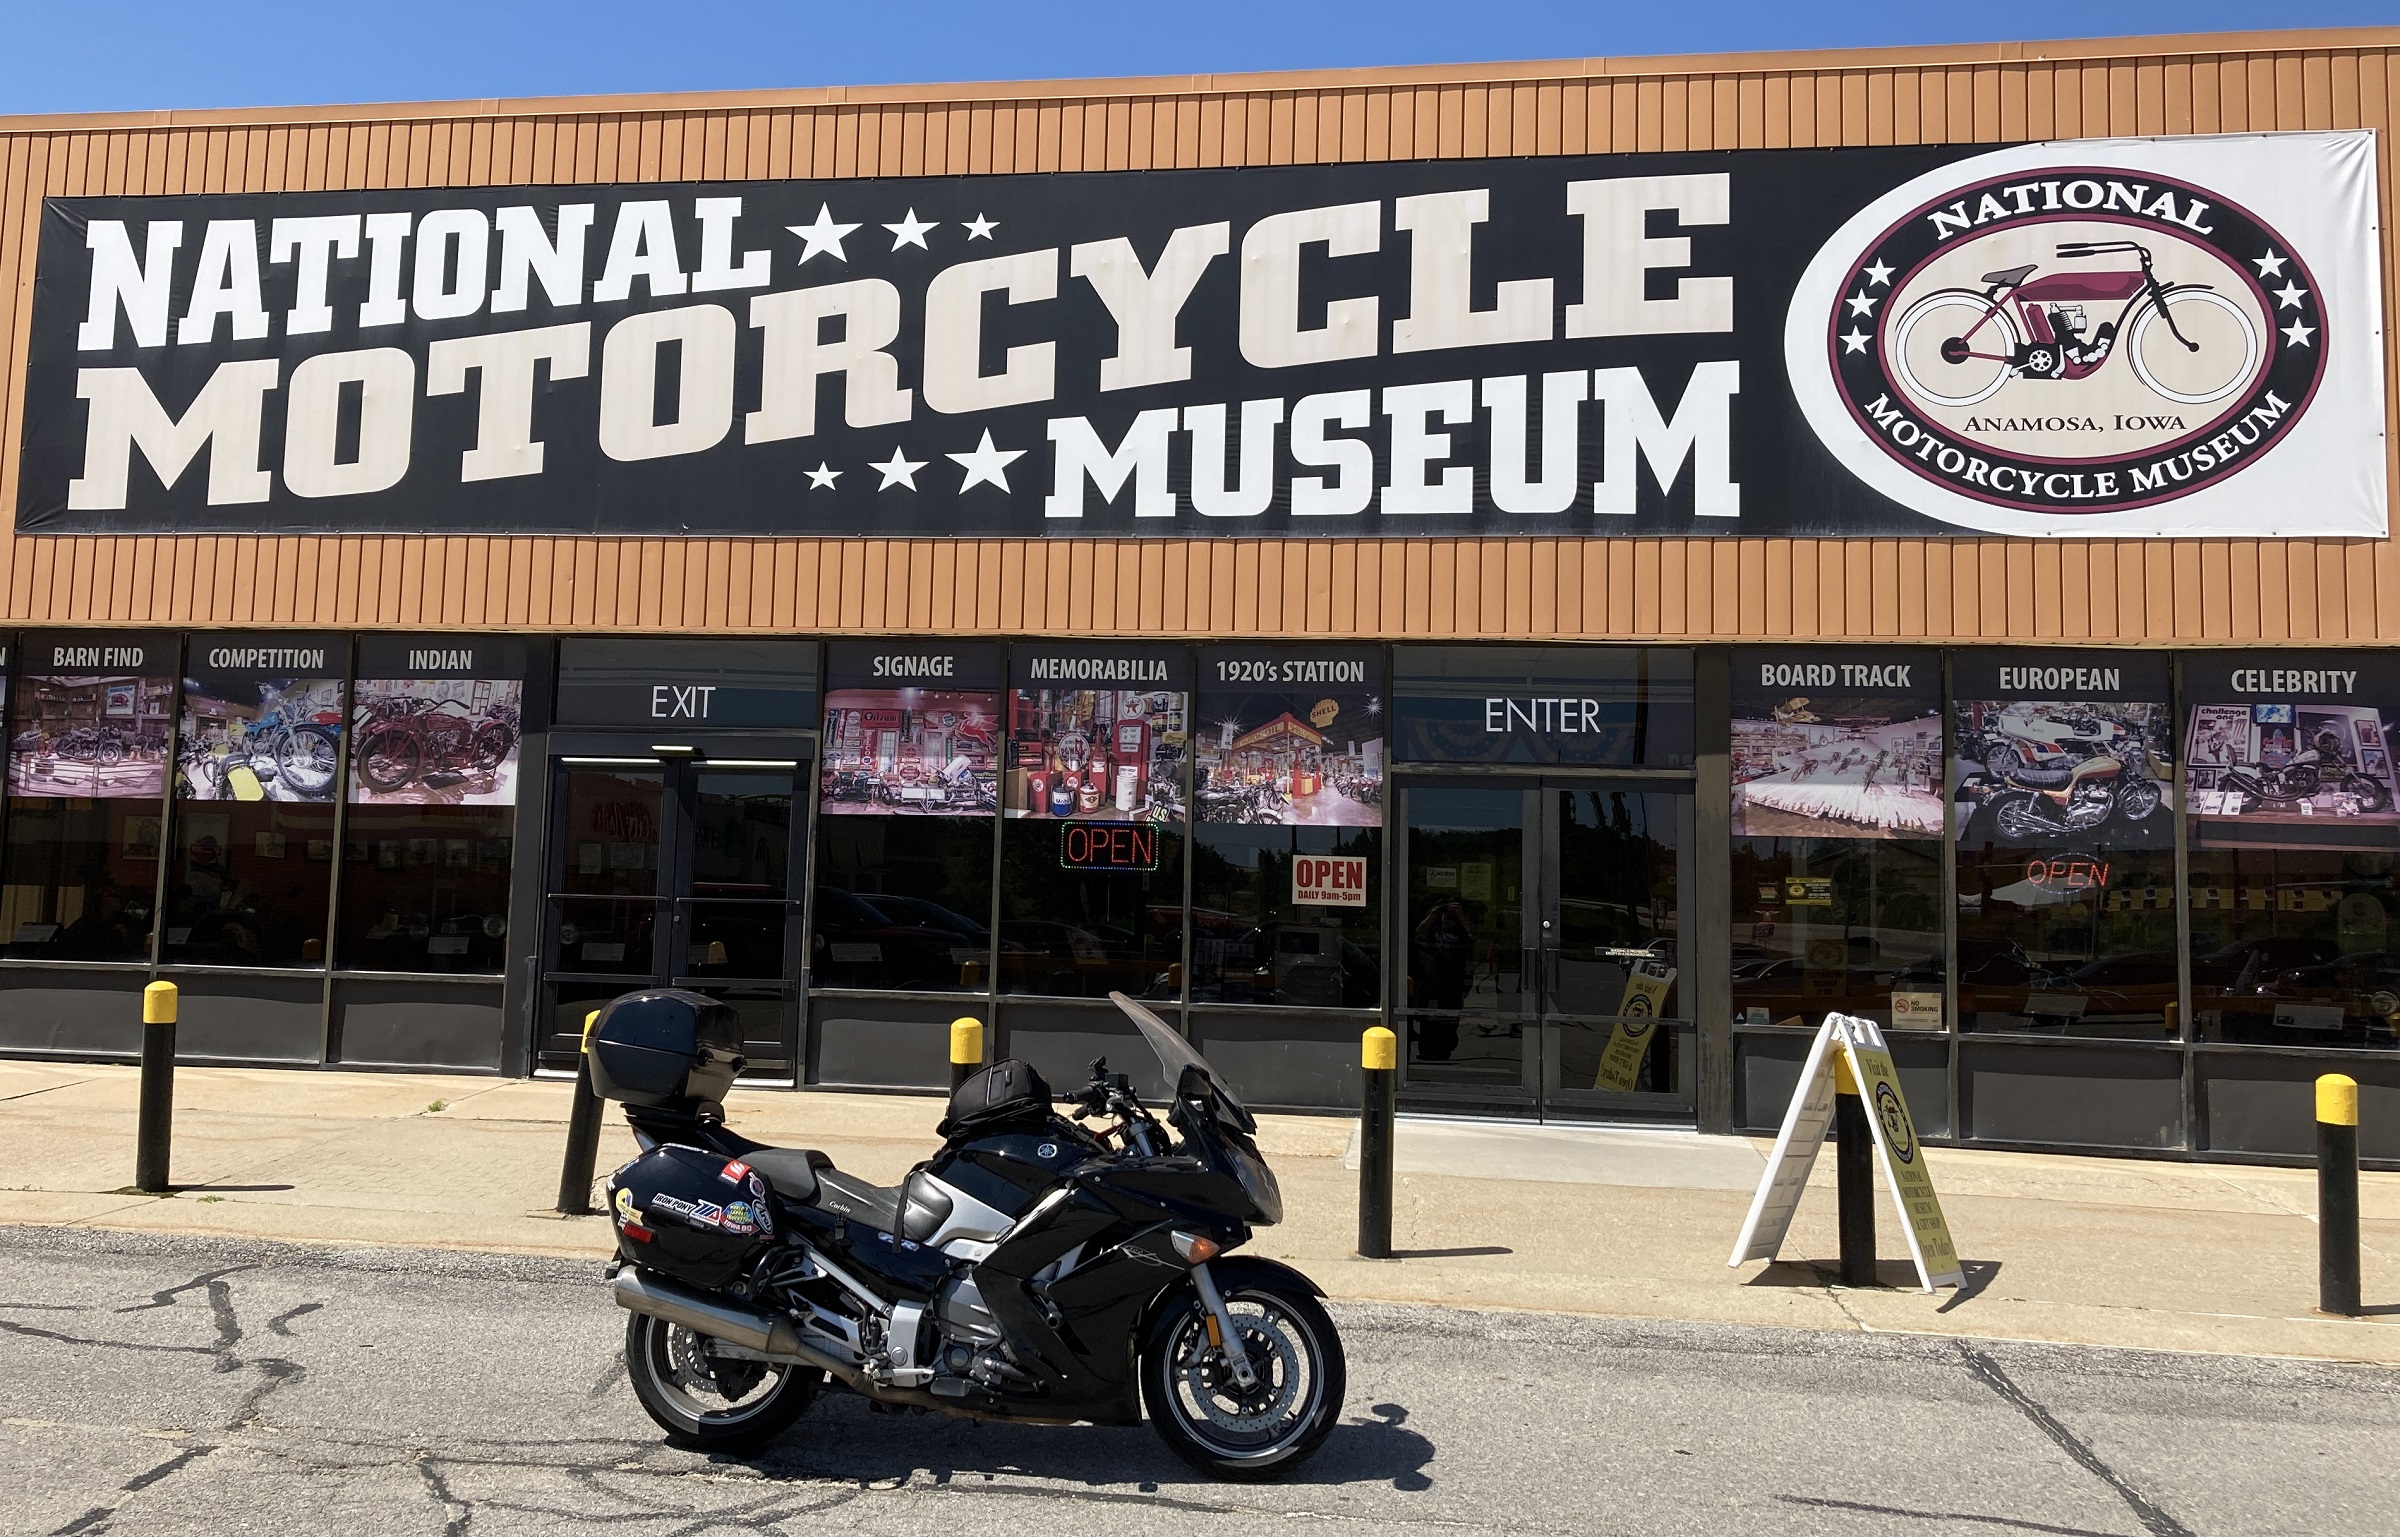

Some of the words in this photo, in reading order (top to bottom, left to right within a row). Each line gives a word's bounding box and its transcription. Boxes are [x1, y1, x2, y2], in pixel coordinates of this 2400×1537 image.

[1926, 179, 2214, 241] NATIONAL
[77, 196, 772, 352] NATIONAL
[67, 172, 1733, 511] MOTORCYCLE
[1963, 413, 2104, 434] ANAMOSA,
[2113, 413, 2187, 432] IOWA
[1044, 361, 1740, 518] MUSEUM
[1864, 392, 2121, 499] MOTORCYCLE
[2131, 389, 2292, 495] MUSEUM
[53, 647, 99, 667] BARN
[103, 647, 144, 667] FIND
[208, 647, 325, 669] COMPETITION
[408, 649, 473, 671] INDIAN
[872, 655, 954, 677] SIGNAGE
[1030, 658, 1168, 681] MEMORABILIA
[1216, 660, 1278, 682] 1920's
[1282, 660, 1365, 683] STATION
[1761, 664, 1837, 687] BOARD
[1841, 664, 1911, 688] TRACK
[1999, 667, 2120, 691] EUROPEAN
[2231, 669, 2357, 694] CELEBRITY
[651, 685, 717, 718] EXIT
[1311, 704, 1337, 718] SHELL
[2201, 707, 2247, 717] challenge
[1485, 698, 1601, 733] ENTER
[1264, 725, 1281, 736] OIL
[1068, 828, 1152, 865] OPEN
[1296, 859, 1363, 889] OPEN
[2027, 860, 2109, 887] OPEN
[1298, 890, 1319, 900] DAILY
[1321, 891, 1361, 902] 9am-5pm
[1910, 1005, 1939, 1013] SMOKING
[654, 1194, 673, 1206] IRON
[672, 1199, 694, 1213] PONY
[829, 1200, 851, 1214] Corbin
